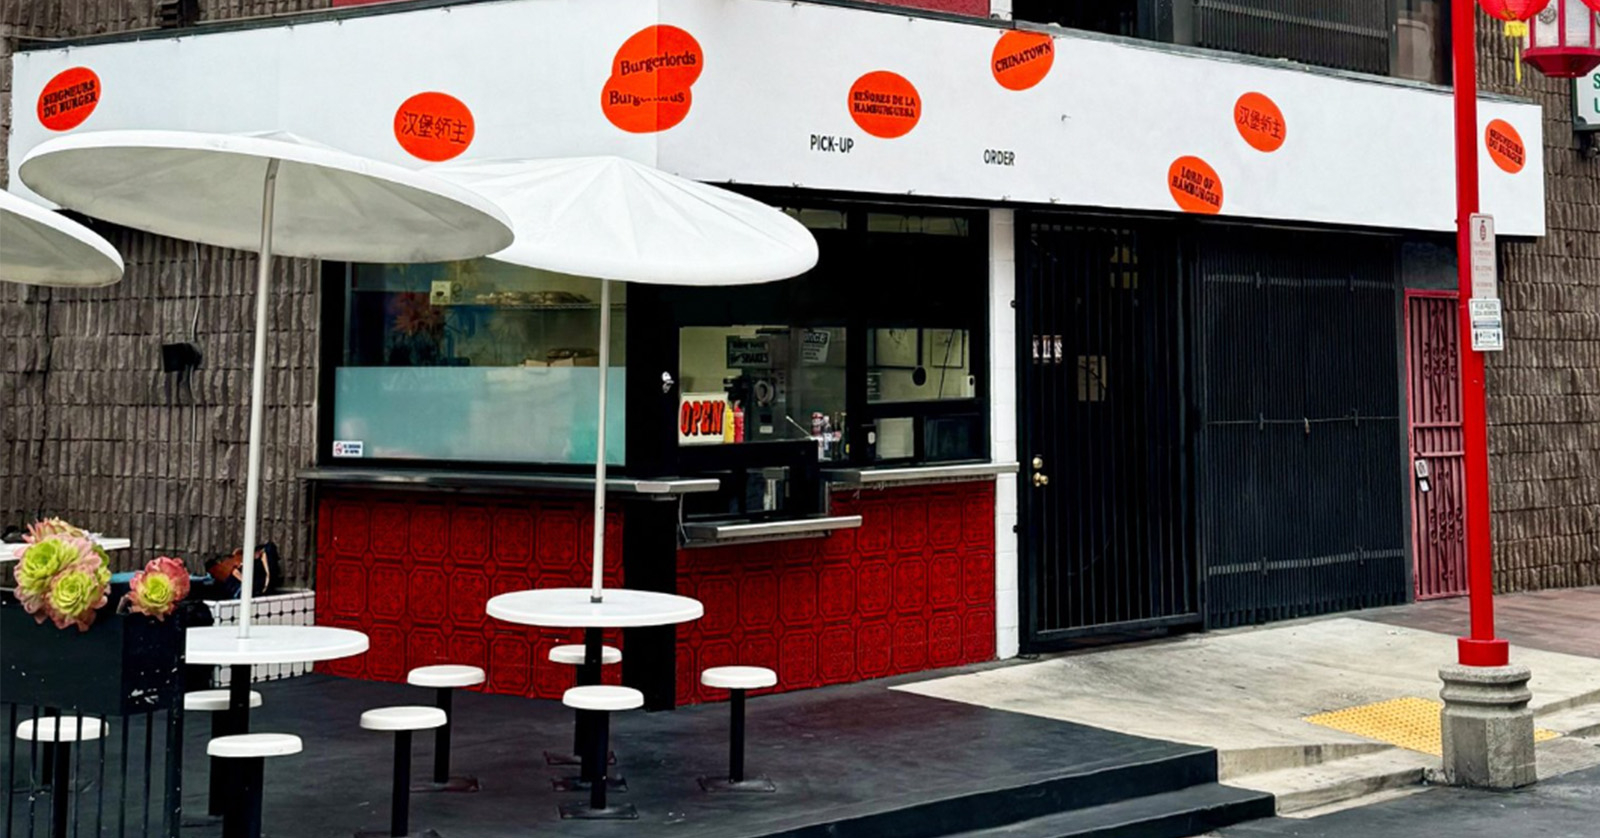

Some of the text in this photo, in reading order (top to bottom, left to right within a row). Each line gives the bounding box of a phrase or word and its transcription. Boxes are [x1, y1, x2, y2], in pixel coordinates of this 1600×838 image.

[620, 50, 696, 76] Burgerlords
[995, 42, 1051, 73] CHINATOWN
[43, 79, 95, 106] SEIGNEURS
[43, 91, 97, 118] DU BURGER
[853, 90, 916, 107] SEÑORES DE LA
[401, 111, 467, 144] 汉堡领主
[810, 134, 854, 153] PICK-UP
[983, 149, 1015, 166] ORDER
[1172, 175, 1220, 207] HAMBURGER
[1181, 166, 1215, 190] LORD OF
[681, 400, 726, 437] OPEN
